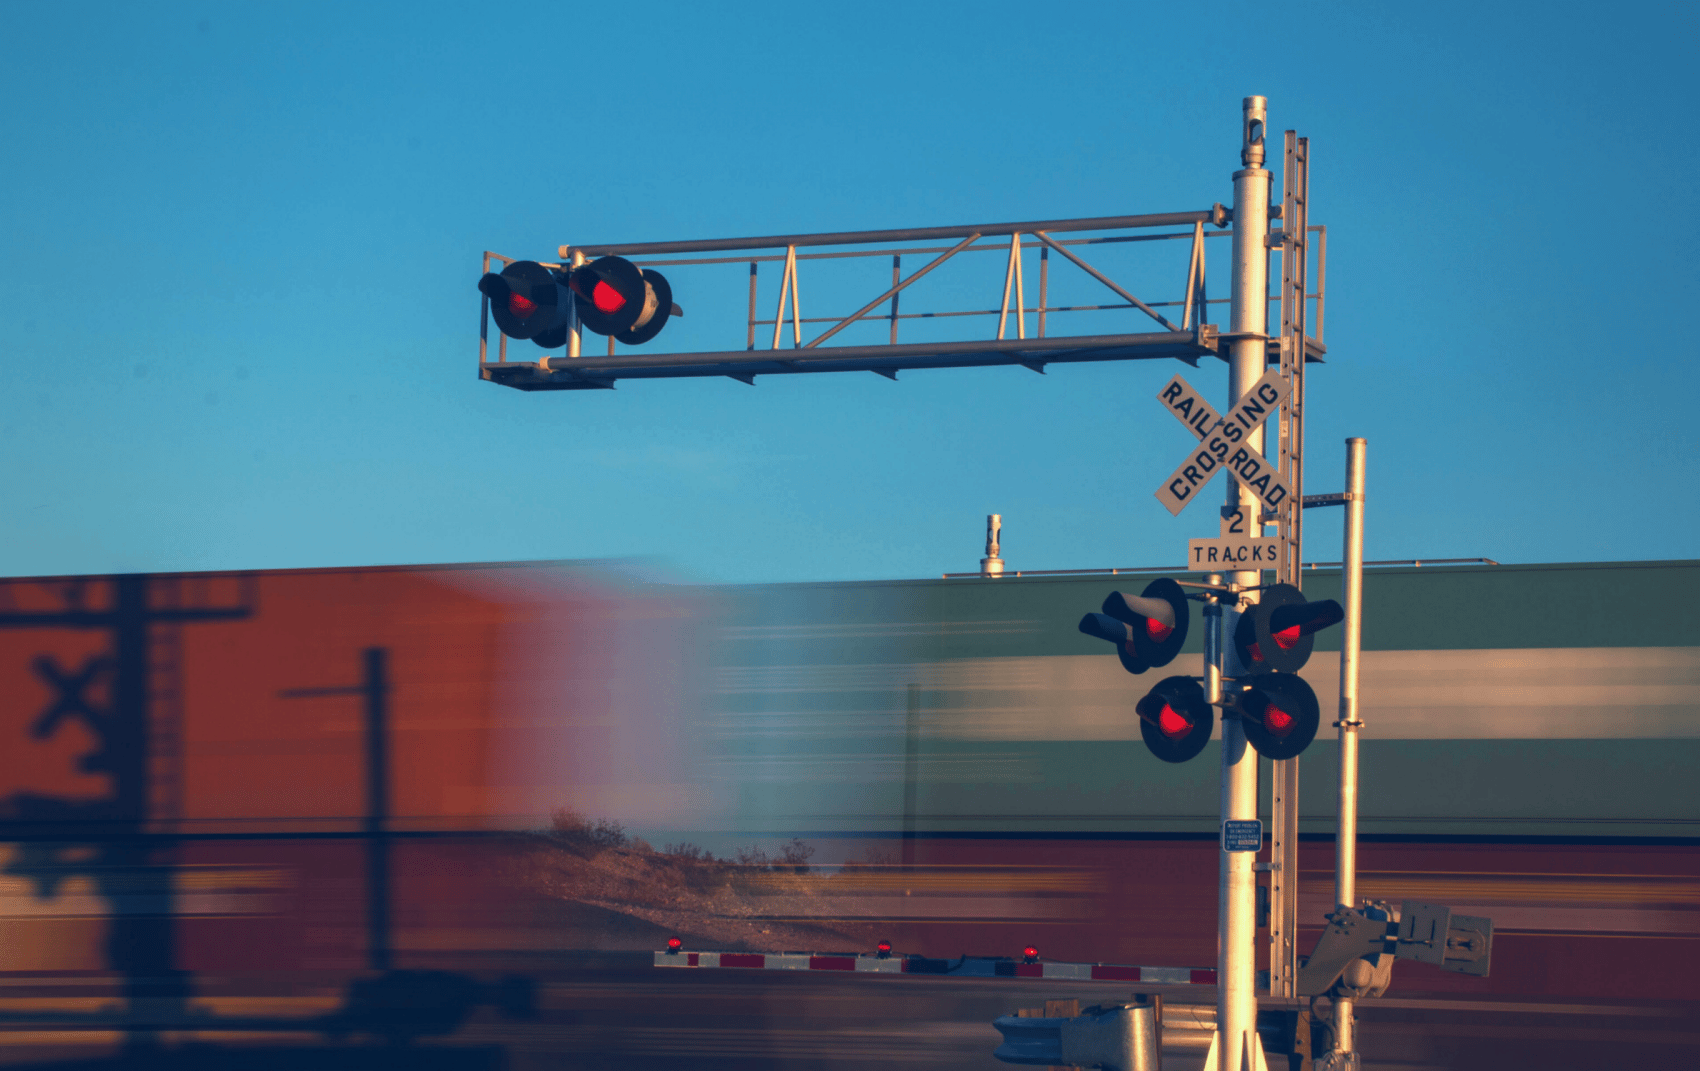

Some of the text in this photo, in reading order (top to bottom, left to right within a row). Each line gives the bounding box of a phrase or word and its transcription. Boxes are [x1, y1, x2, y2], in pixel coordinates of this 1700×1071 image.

[1162, 381, 1287, 507] RAIL ROAD
[1168, 383, 1279, 501] CROSSING
[1194, 545, 1277, 562] TRACKS
[1228, 511, 1244, 533] 2
